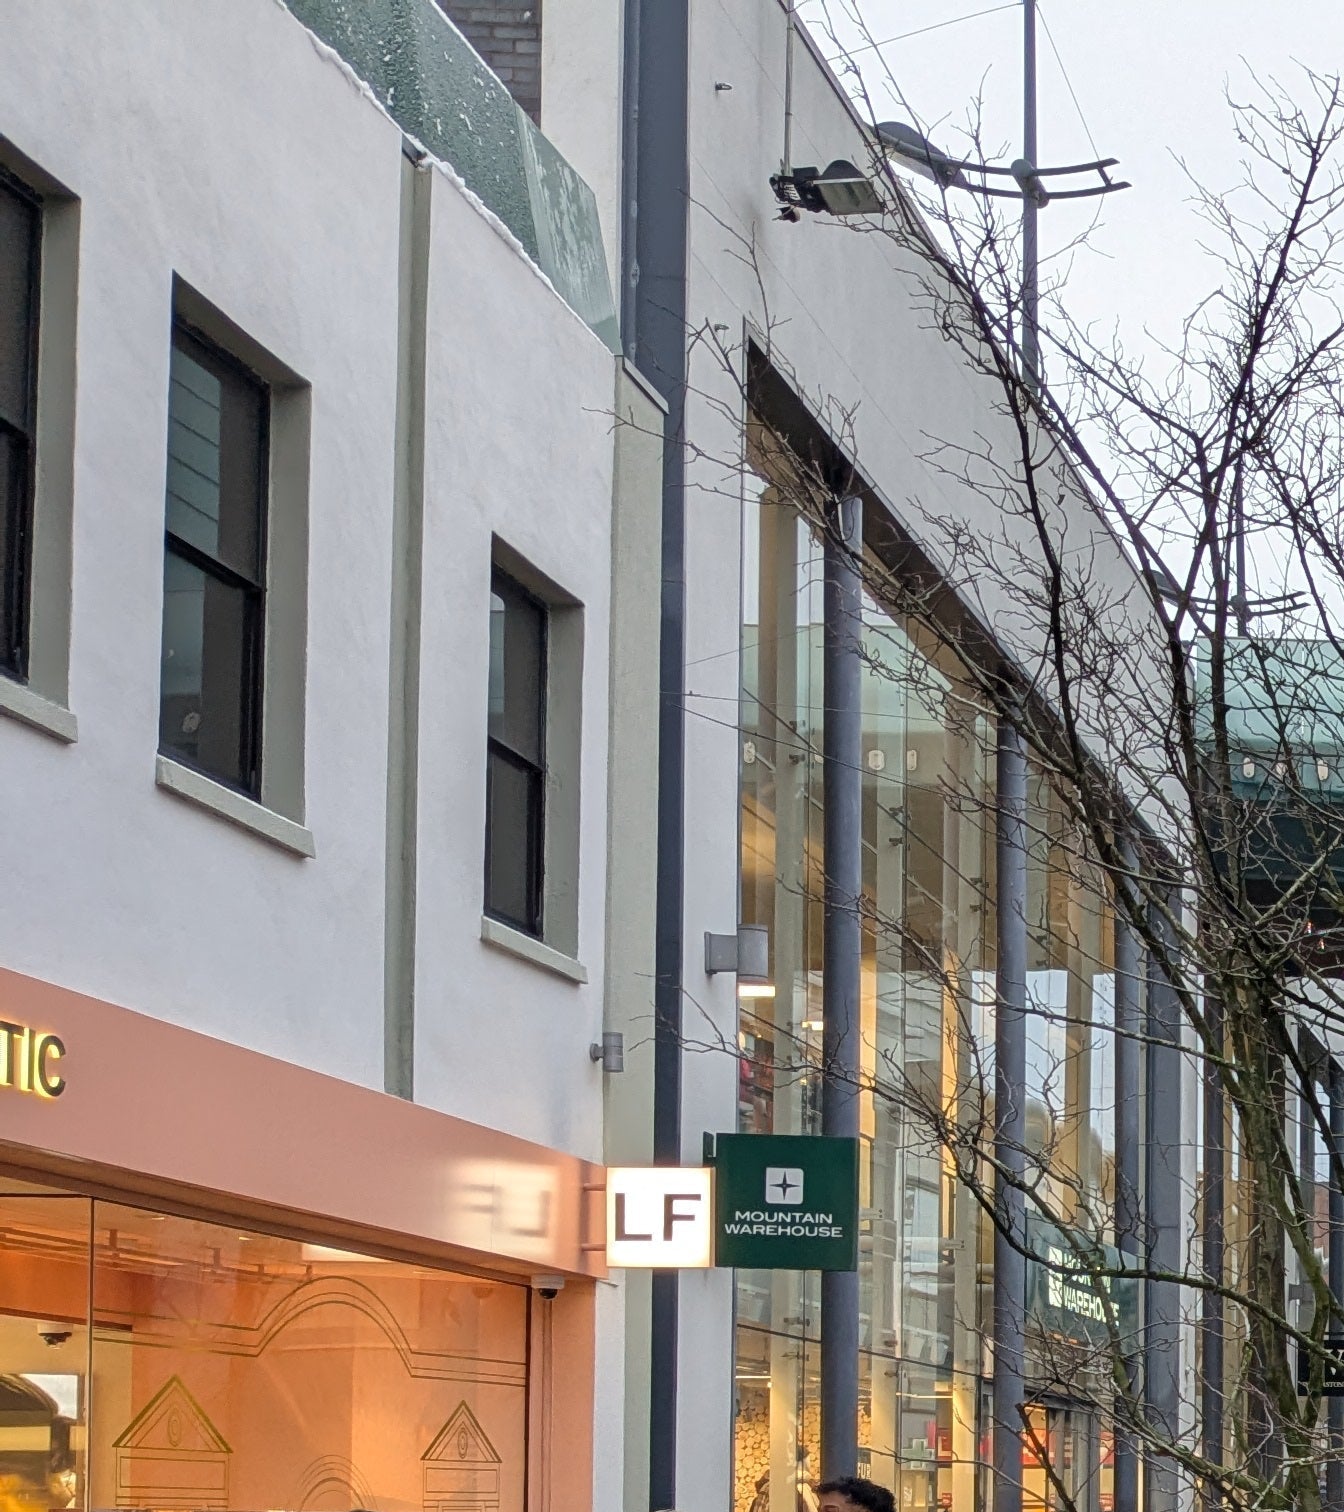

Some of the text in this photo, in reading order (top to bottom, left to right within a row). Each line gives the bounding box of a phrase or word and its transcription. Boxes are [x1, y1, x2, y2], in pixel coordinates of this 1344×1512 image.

[614, 1192, 702, 1242] LF
[735, 1210, 833, 1224] MOUNTAIN
[724, 1223, 843, 1238] WAREHOUSE
